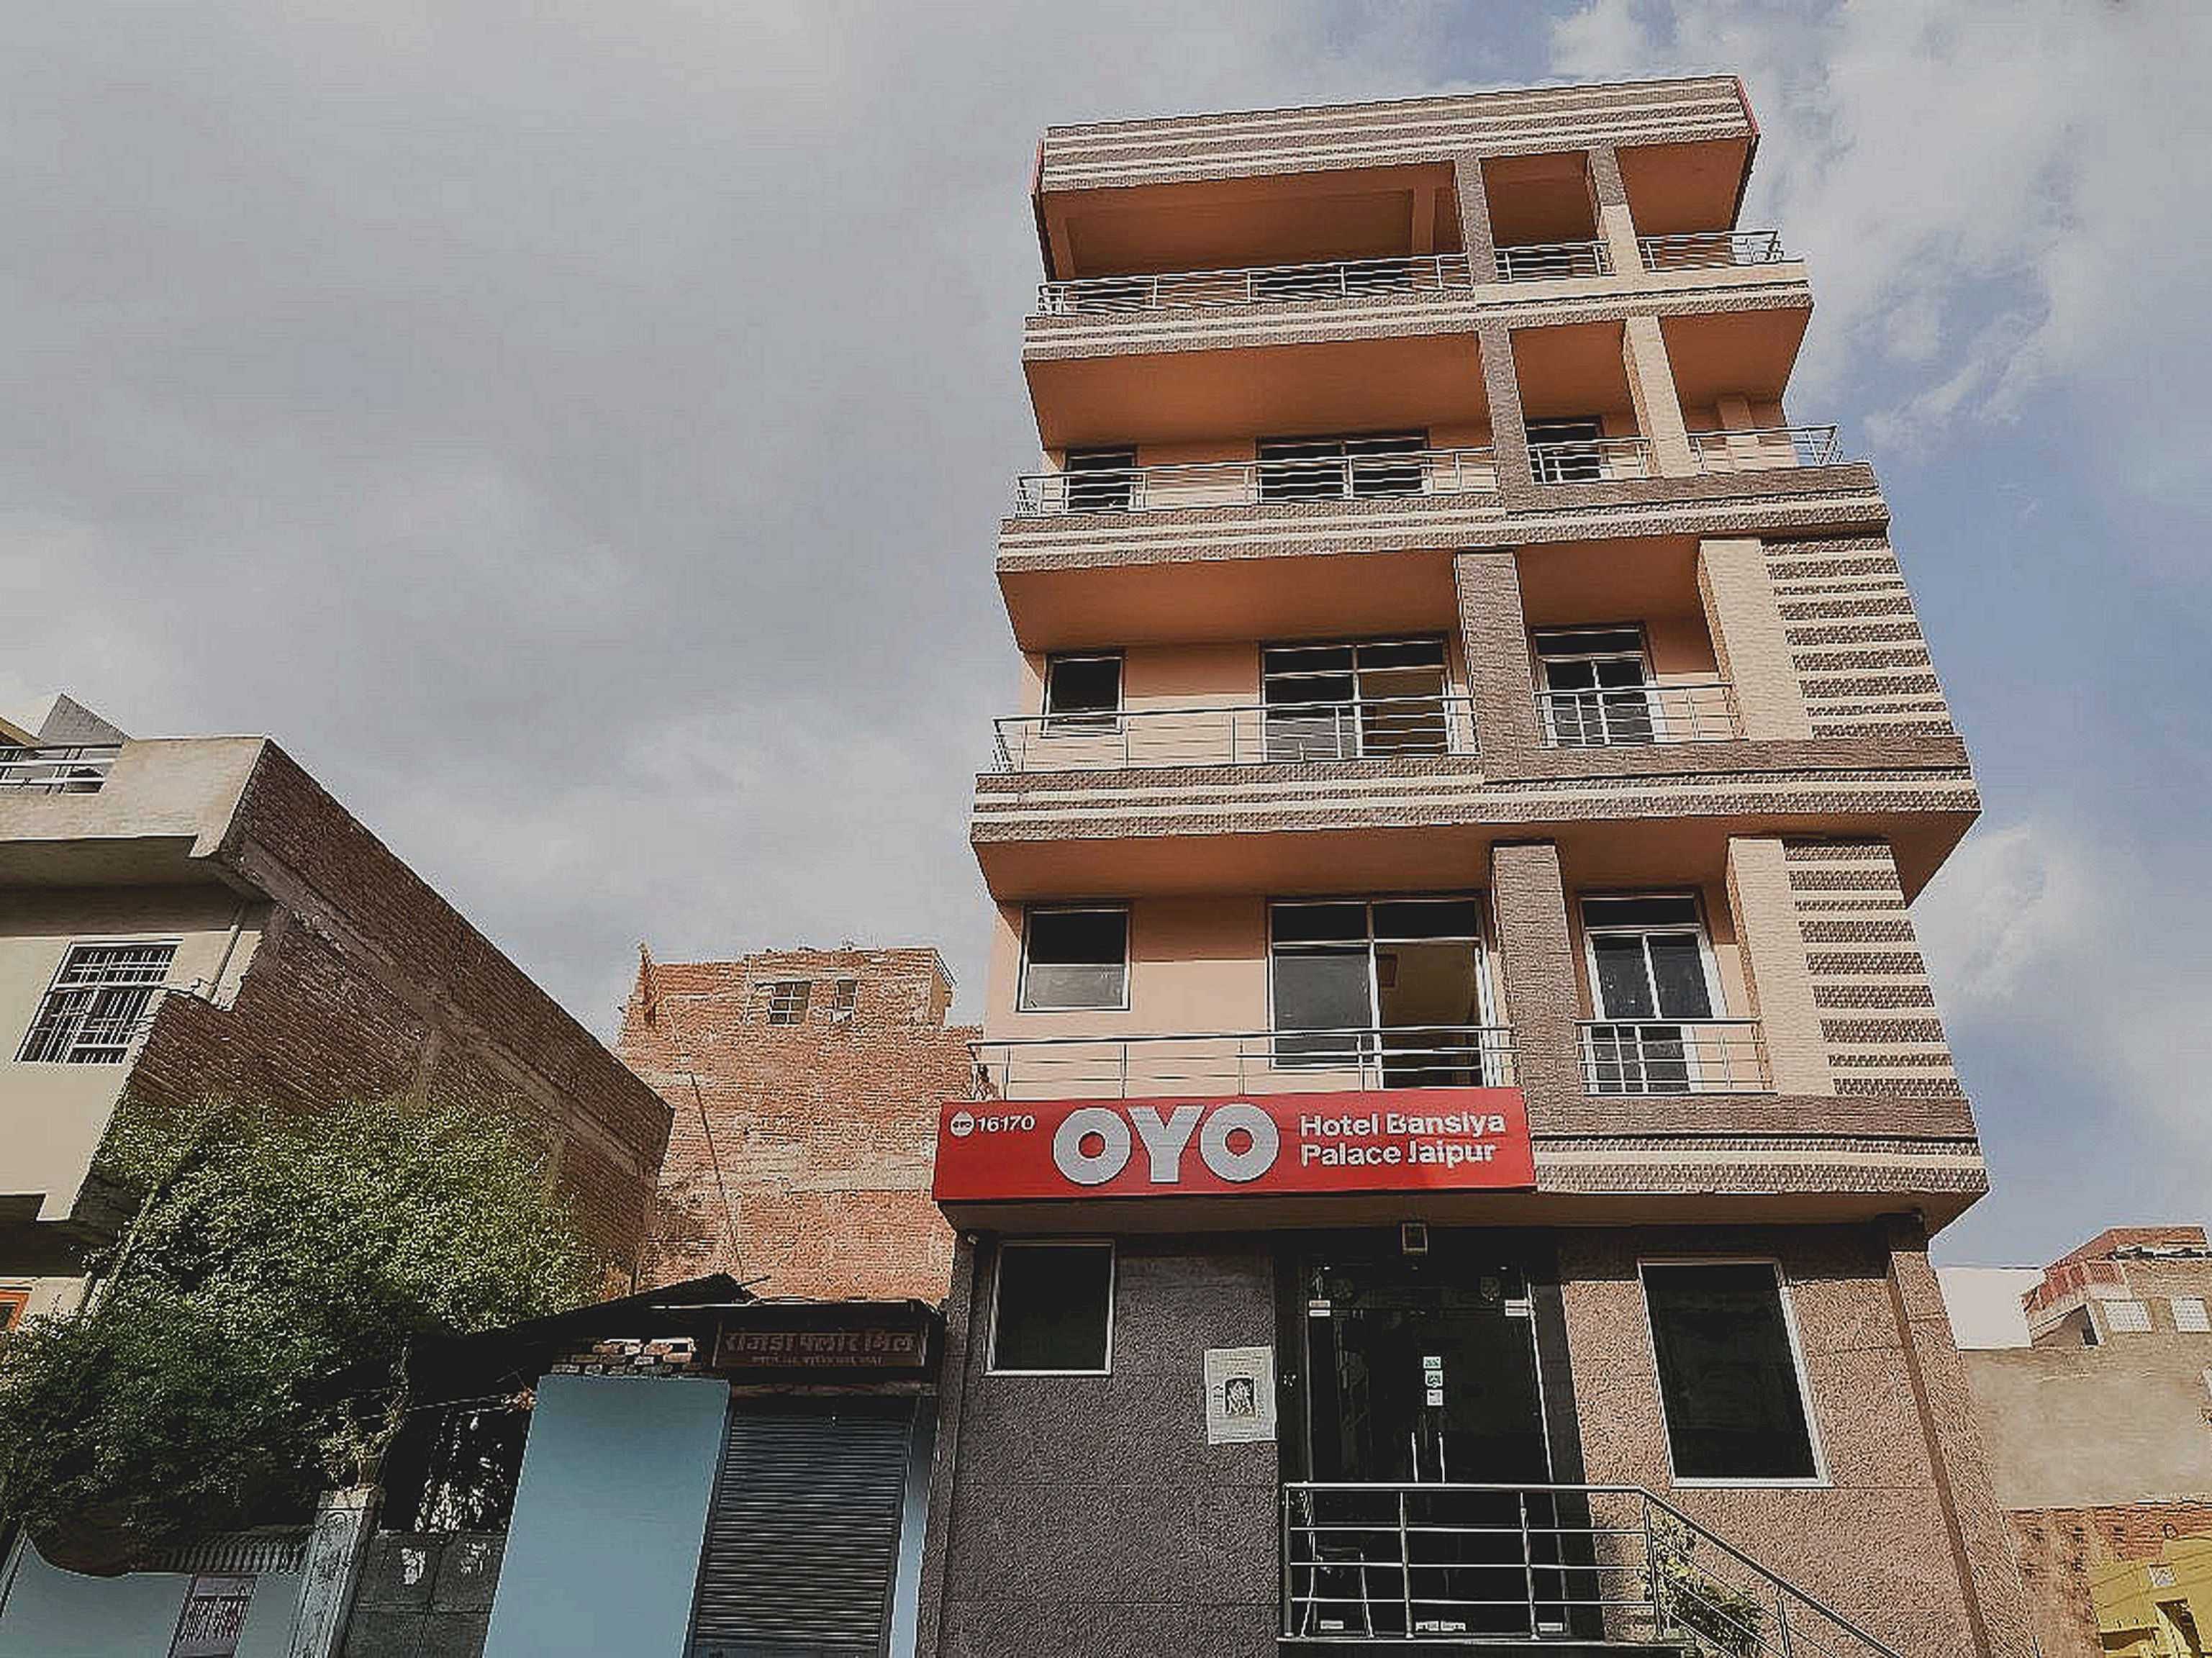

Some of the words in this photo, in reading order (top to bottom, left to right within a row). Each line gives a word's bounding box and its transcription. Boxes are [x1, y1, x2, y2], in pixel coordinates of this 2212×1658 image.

[978, 1115, 1035, 1132] 16170
[1300, 1113, 1379, 1137] Hotel
[1387, 1112, 1506, 1137] Bansiya
[1053, 1103, 1279, 1184] OYO
[1300, 1142, 1402, 1167] Palace
[1408, 1140, 1496, 1168] Jaipur
